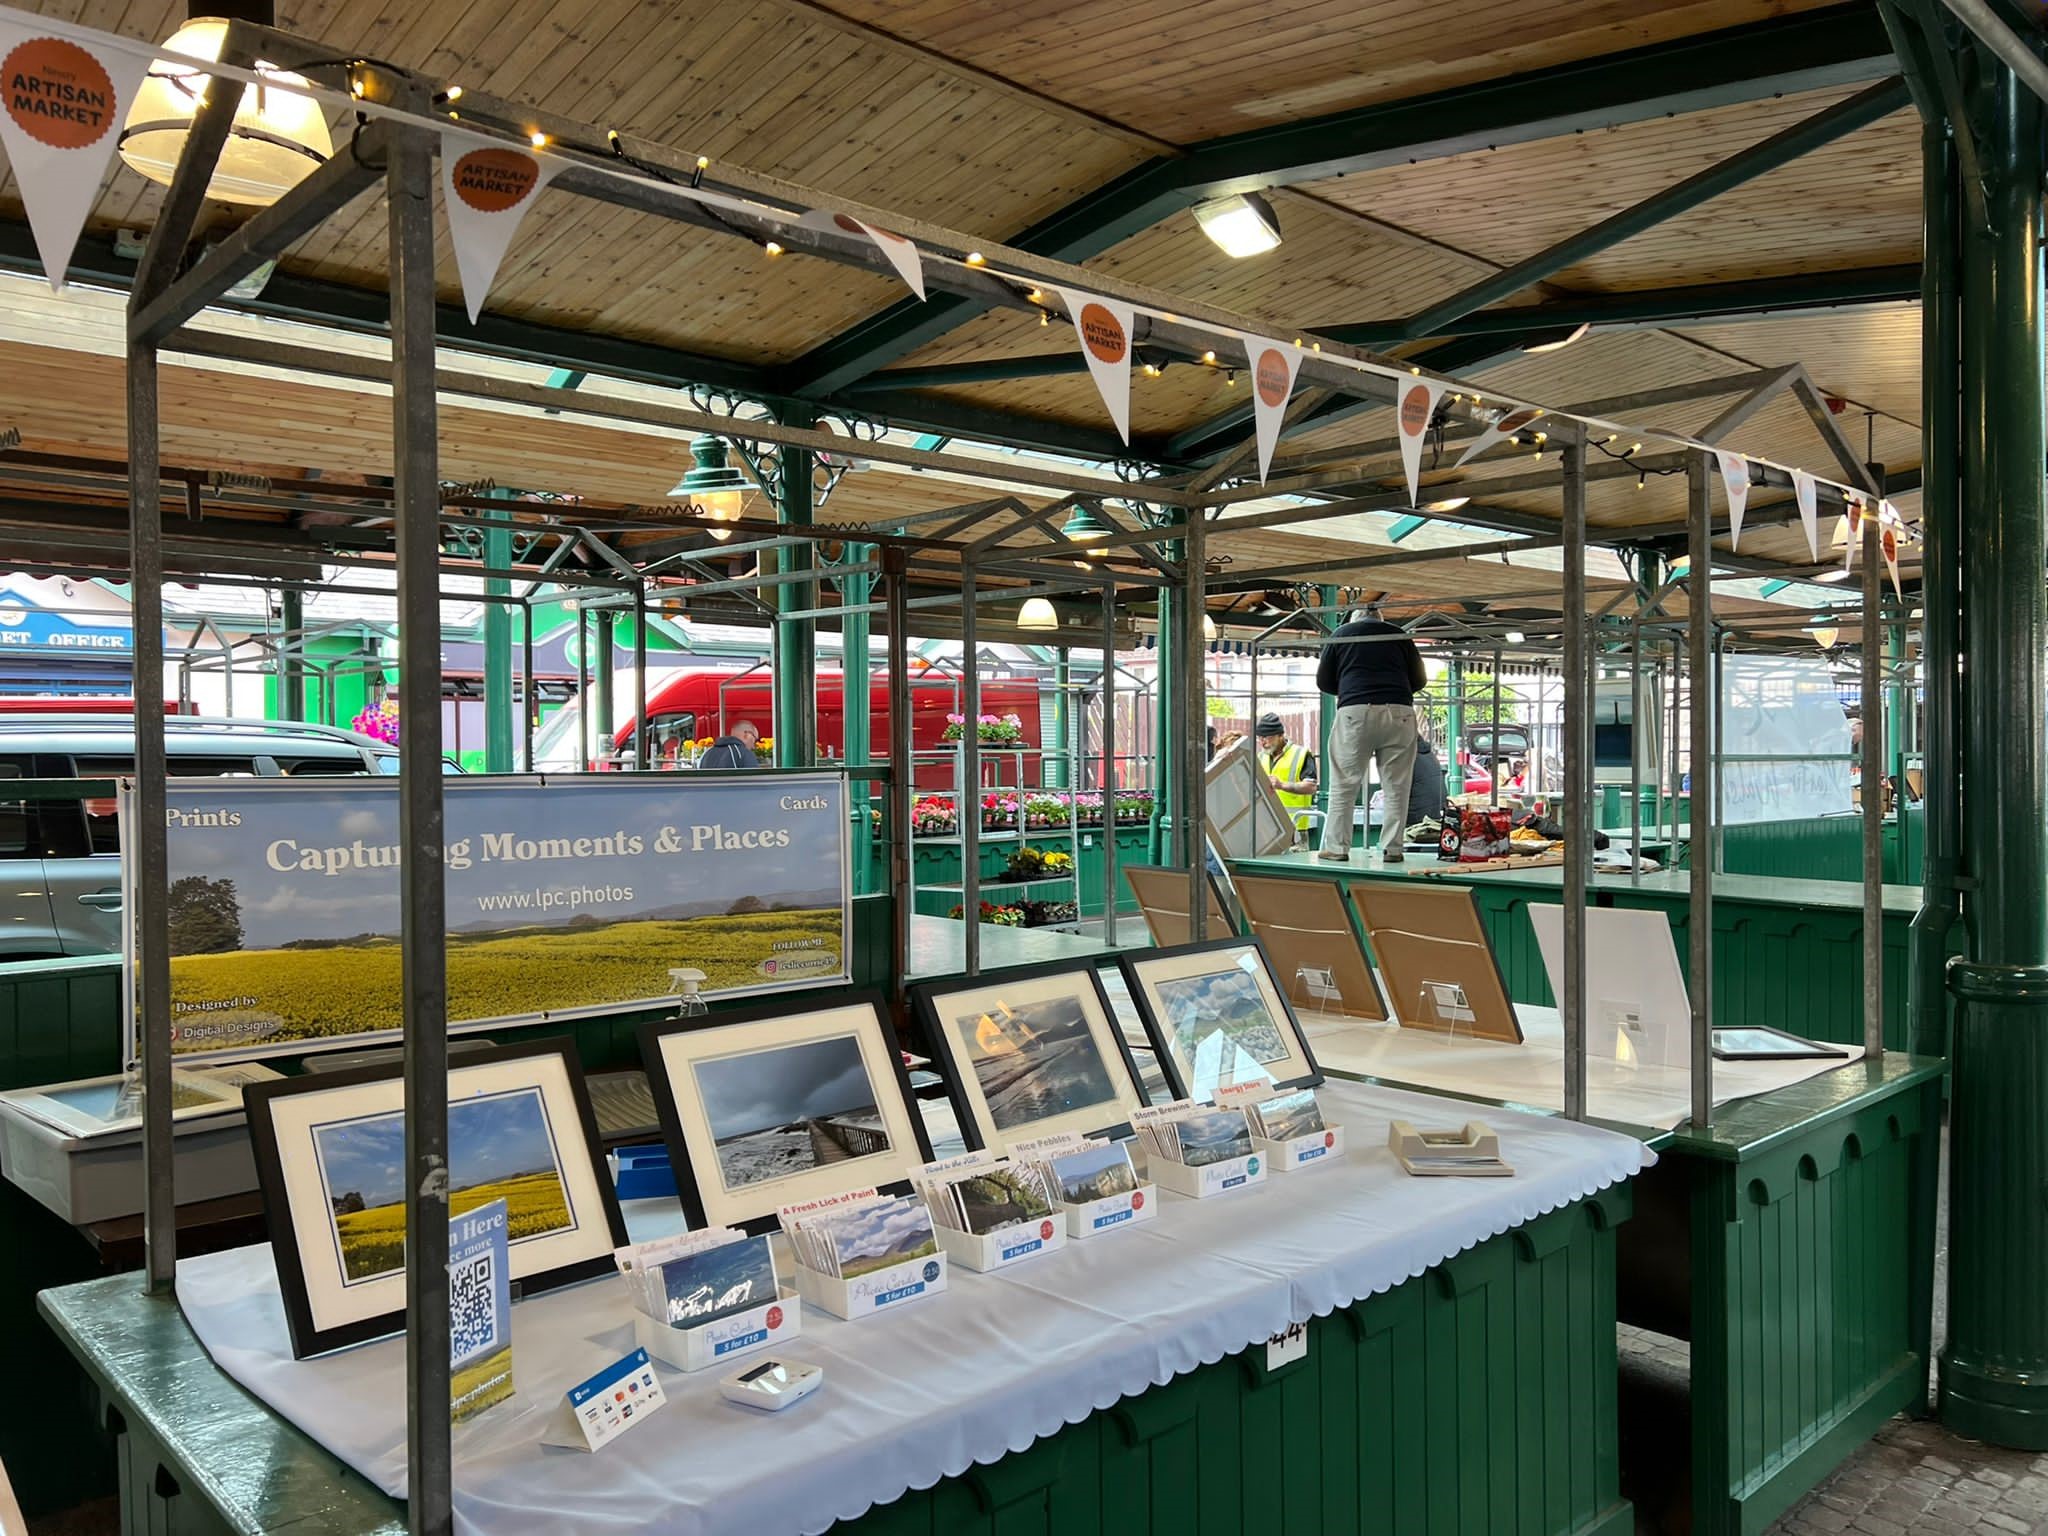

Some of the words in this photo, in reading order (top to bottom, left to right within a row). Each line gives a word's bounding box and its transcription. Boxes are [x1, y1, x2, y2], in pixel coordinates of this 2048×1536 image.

[12, 73, 106, 108] ARTISAN
[13, 95, 103, 127] MARKET
[462, 163, 530, 182] ARTISAN
[460, 176, 524, 195] MARKET
[1085, 322, 1121, 339] ARTISAN
[1087, 334, 1122, 351] MARKET
[0, 631, 31, 644] ET
[48, 633, 124, 648] OFFICE
[780, 795, 828, 811] Cards
[165, 808, 241, 827] Prints
[266, 838, 473, 876] Captug
[480, 829, 643, 862] Moments
[654, 826, 682, 854] &
[690, 824, 790, 851] Places
[478, 885, 633, 912] www.lpc.photos
[176, 997, 238, 1013] Designed
[243, 995, 258, 1008] by
[184, 1024, 225, 1039] Digital
[227, 1020, 274, 1034] Designs
[1134, 1110, 1158, 1120] Storm
[1016, 1142, 1037, 1153] Nice
[1037, 1134, 1072, 1148] Pebbles
[783, 1207, 790, 1215] A
[791, 1202, 818, 1214] Fresh
[819, 1197, 837, 1208] Lick
[840, 1194, 849, 1203] of
[850, 1188, 875, 1200] Paint
[463, 1213, 503, 1241] Here
[464, 1237, 493, 1257] more
[891, 1290, 902, 1300] for
[902, 1285, 917, 1296] £10
[723, 1343, 730, 1352] 5
[730, 1338, 743, 1349] for
[743, 1332, 760, 1345] £10
[1272, 1322, 1302, 1349] 44
